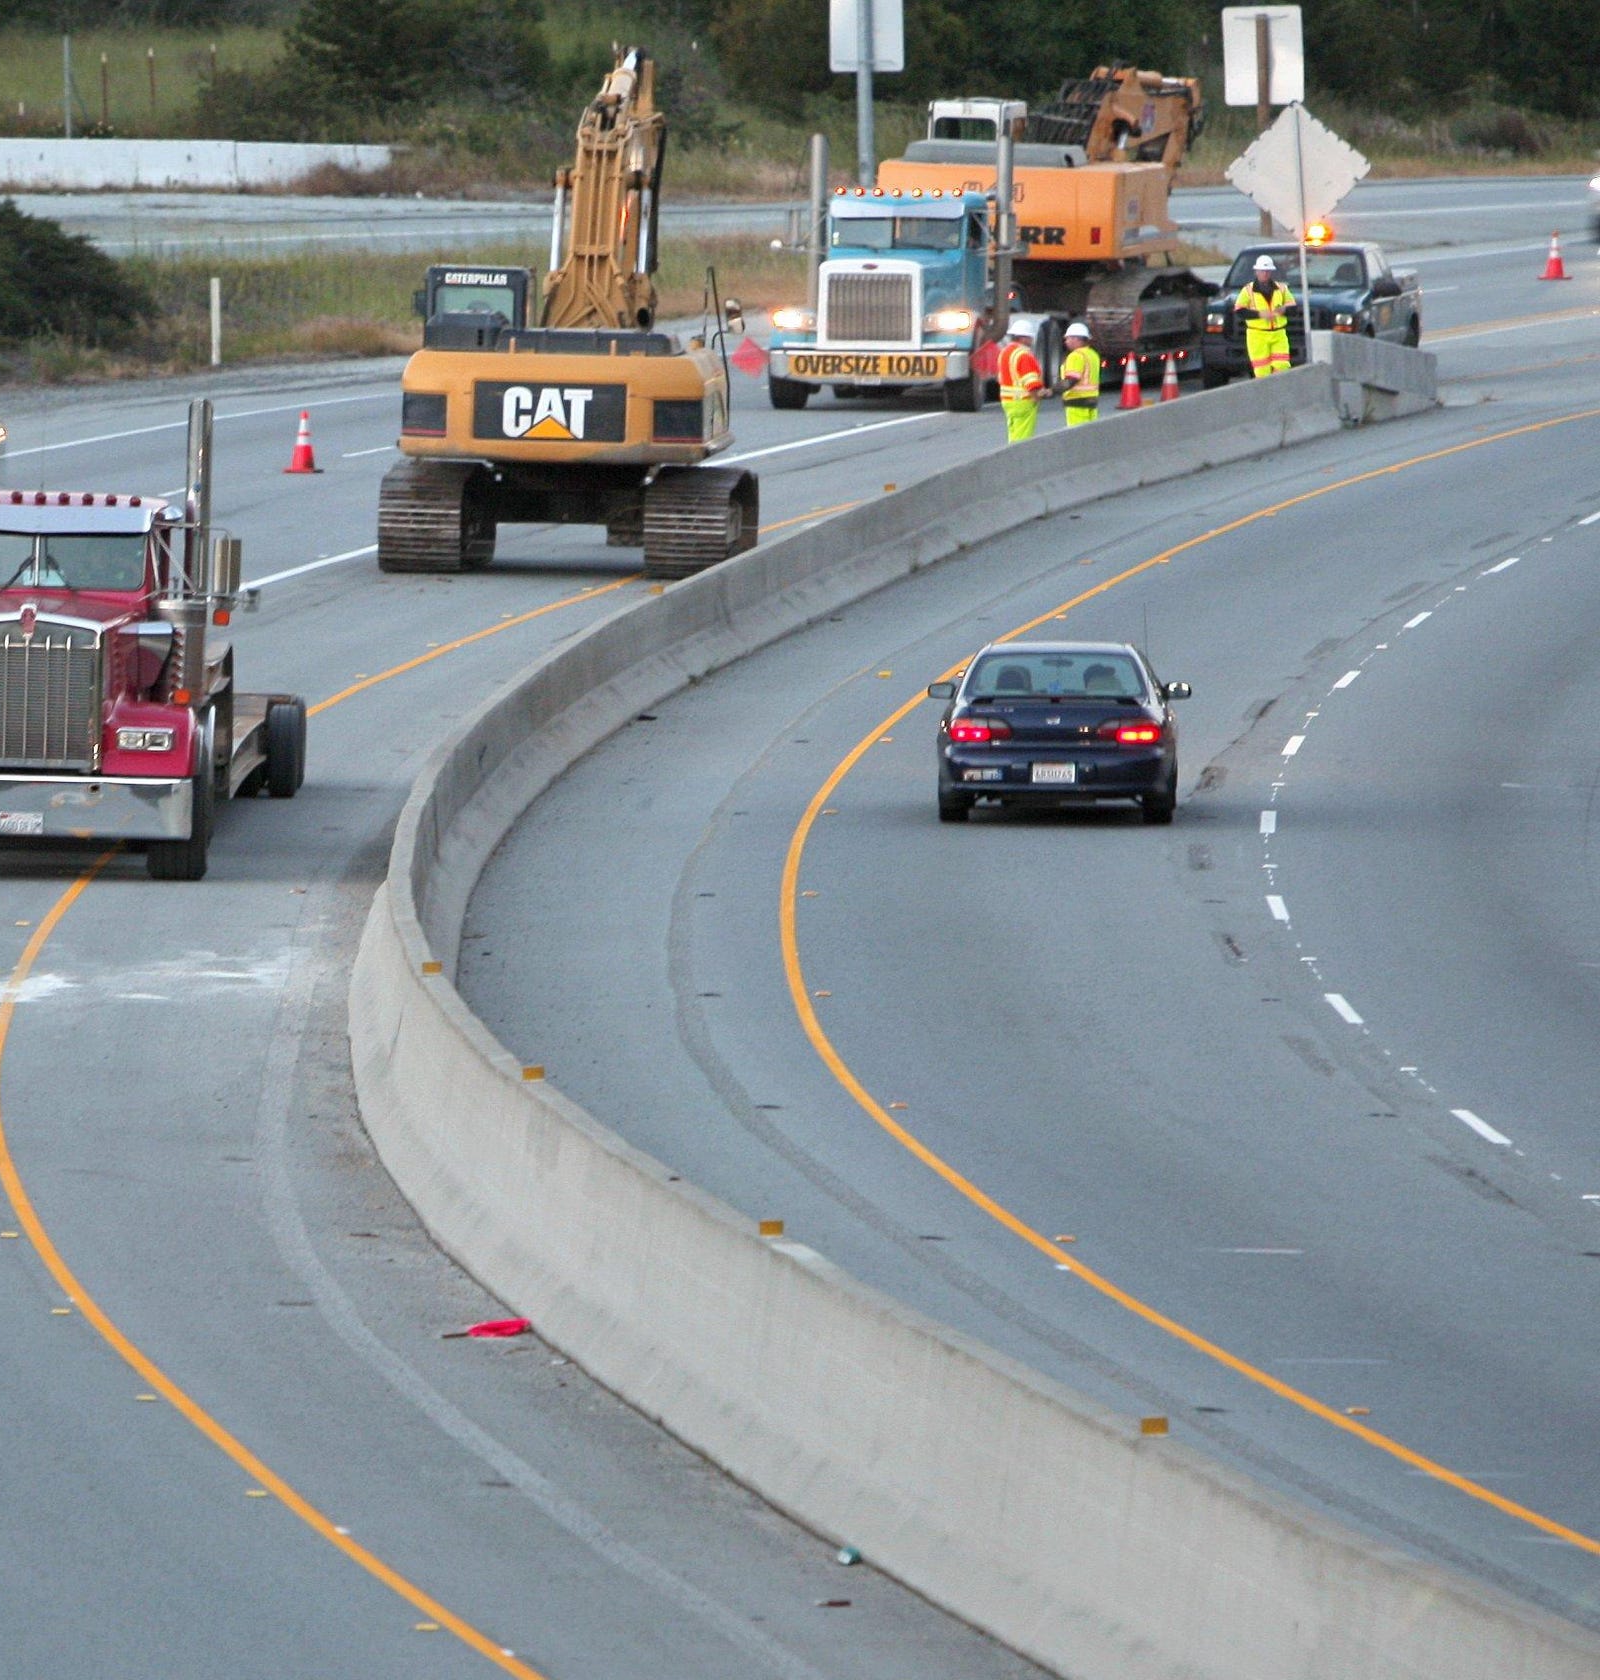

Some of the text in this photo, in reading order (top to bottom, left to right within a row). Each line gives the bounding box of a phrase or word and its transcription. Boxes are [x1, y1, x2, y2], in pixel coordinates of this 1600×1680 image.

[445, 272, 507, 285] CATERPILLAR
[794, 355, 938, 376] OVERSIZE LOAD
[502, 386, 593, 439] CAT
